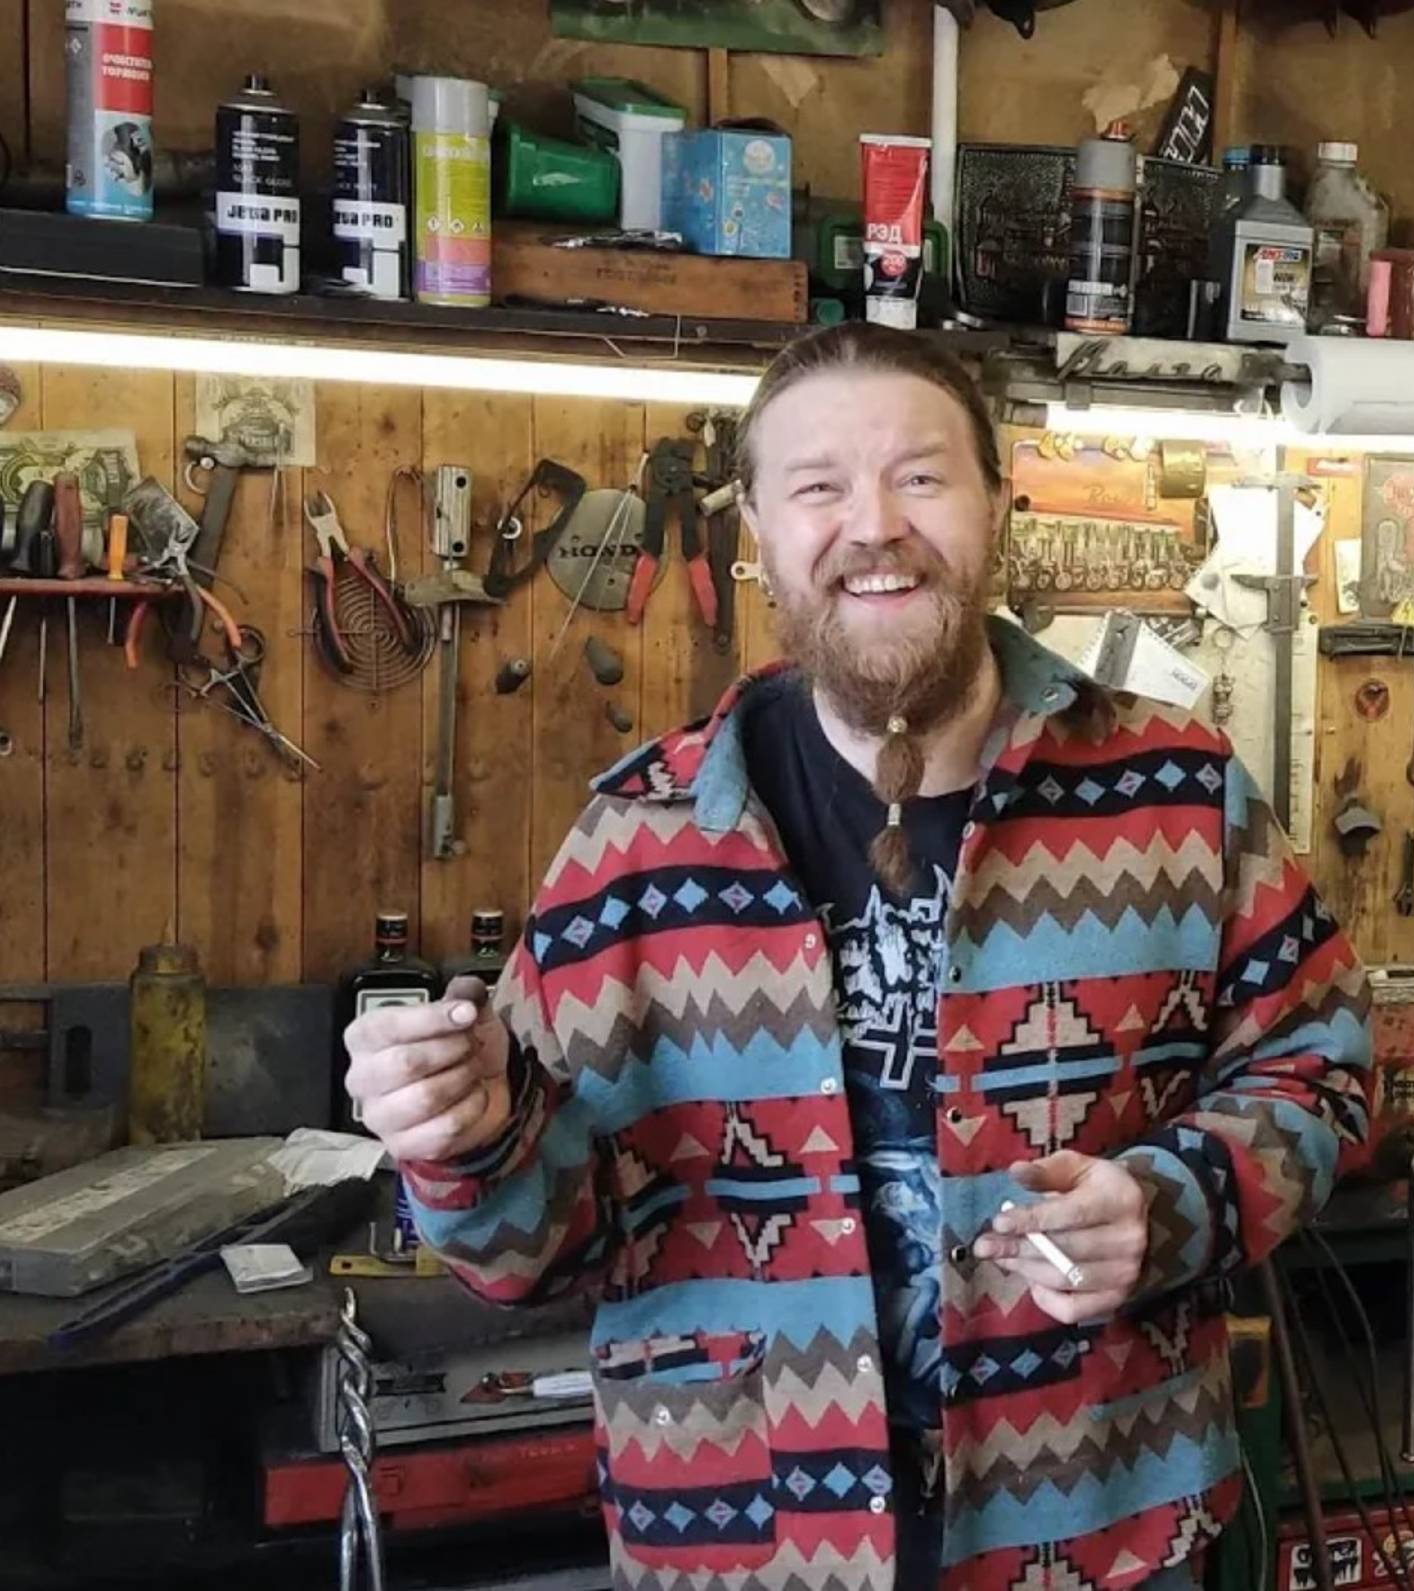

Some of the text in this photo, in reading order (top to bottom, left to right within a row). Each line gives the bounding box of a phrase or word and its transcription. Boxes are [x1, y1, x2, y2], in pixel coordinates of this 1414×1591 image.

[362, 213, 394, 229] PRO
[867, 223, 903, 244] РЭД
[559, 544, 640, 558] HOND
